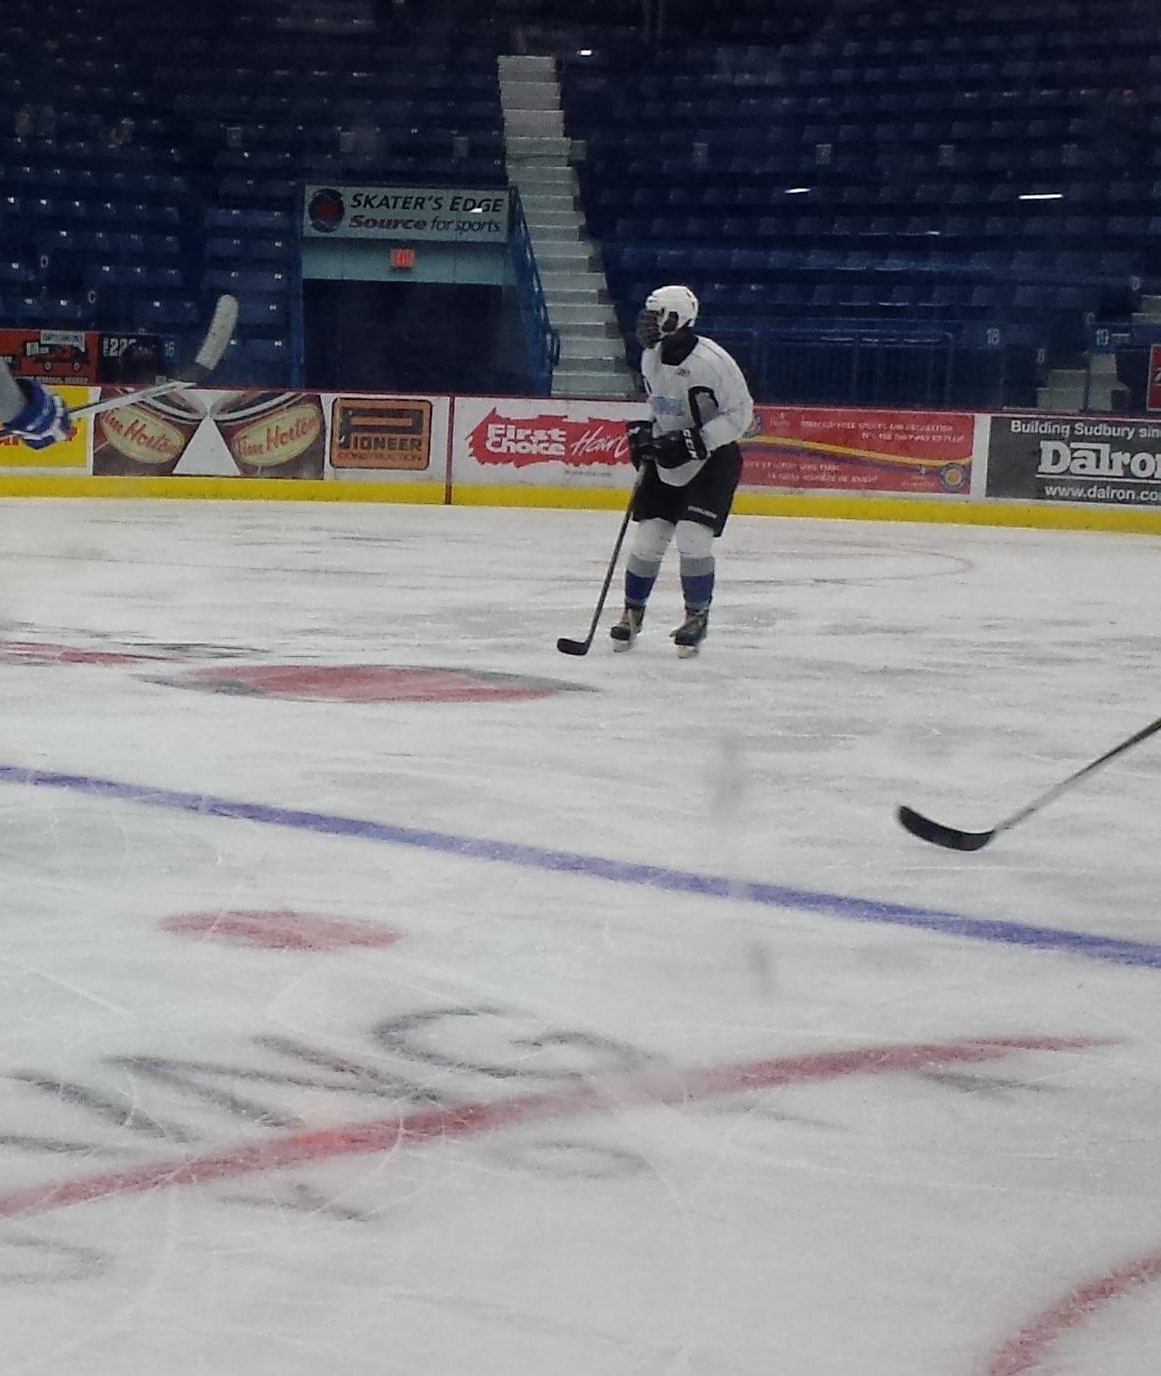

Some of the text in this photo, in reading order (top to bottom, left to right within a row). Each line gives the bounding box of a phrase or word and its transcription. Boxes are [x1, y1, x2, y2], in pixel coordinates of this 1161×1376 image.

[350, 193, 505, 213] SKATER'S EDGE
[350, 215, 501, 235] Source for sports
[1010, 420, 1071, 436] Building
[1074, 423, 1136, 440] Sudbury
[485, 435, 566, 456] Choice
[486, 424, 629, 457] First HairC
[1037, 440, 1161, 478] Dalro
[1044, 485, 1161, 501] www.dalron.co
